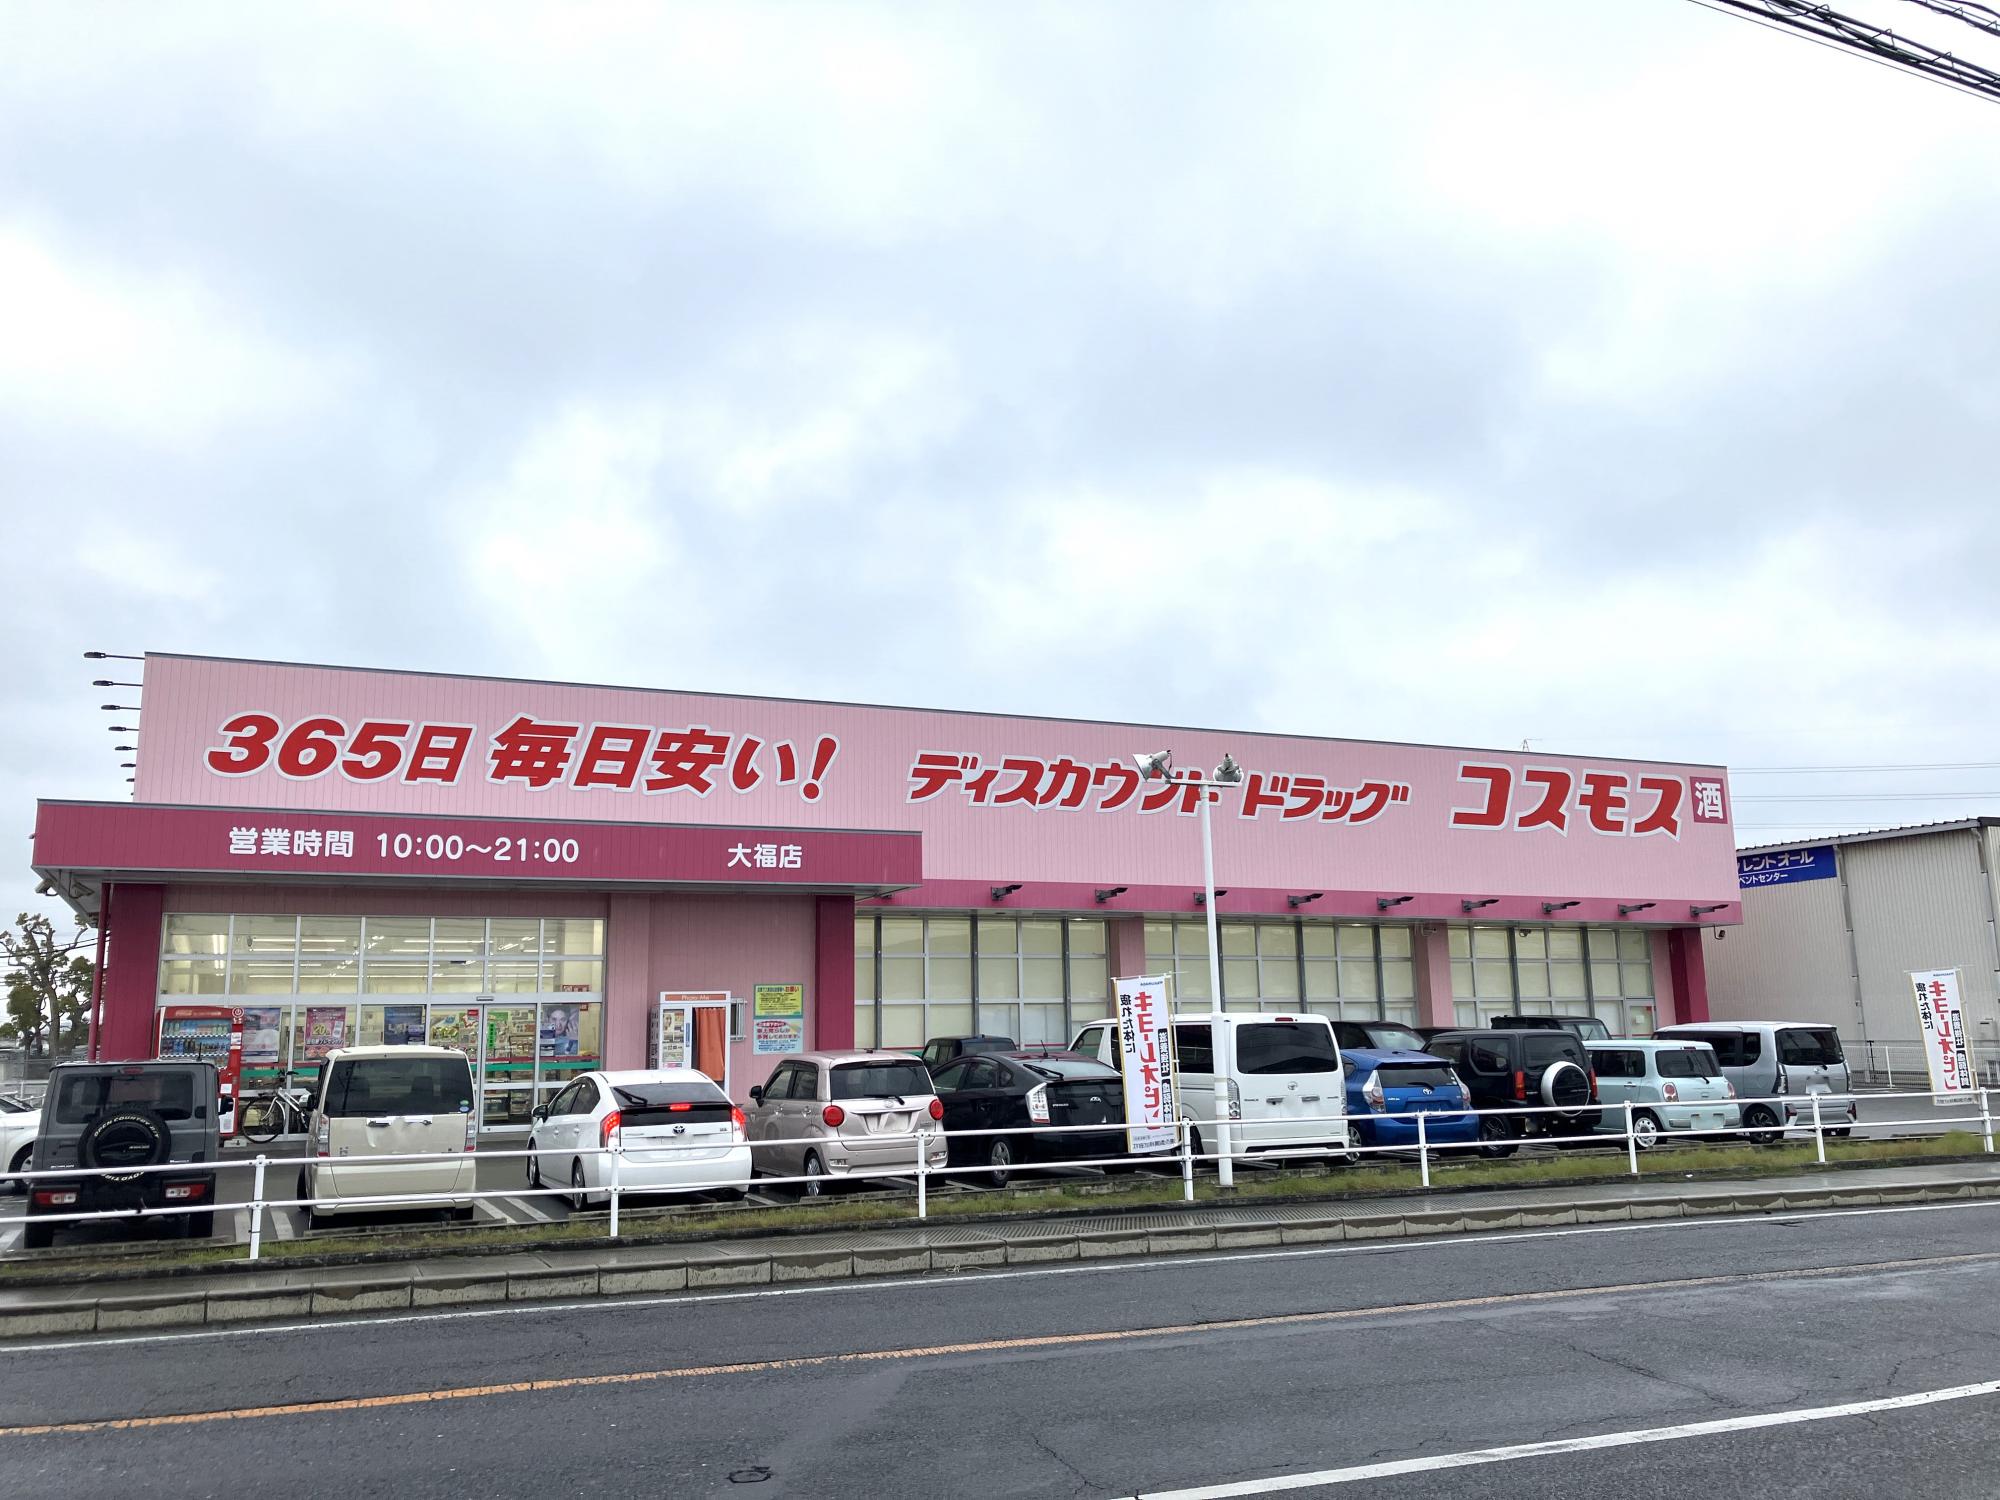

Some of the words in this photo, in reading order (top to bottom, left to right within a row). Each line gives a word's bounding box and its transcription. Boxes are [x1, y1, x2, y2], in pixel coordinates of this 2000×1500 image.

[206, 712, 474, 784] 365日
[490, 716, 838, 802] 毎日安い!
[909, 752, 1221, 814] ディスカウント
[1241, 773, 1411, 825] ドラッグ
[1452, 763, 1685, 836] コスモス
[1695, 782, 1724, 819] 酒
[229, 827, 354, 858] 営業時間
[727, 843, 802, 868] 大福店
[1738, 851, 1814, 872] レントオール
